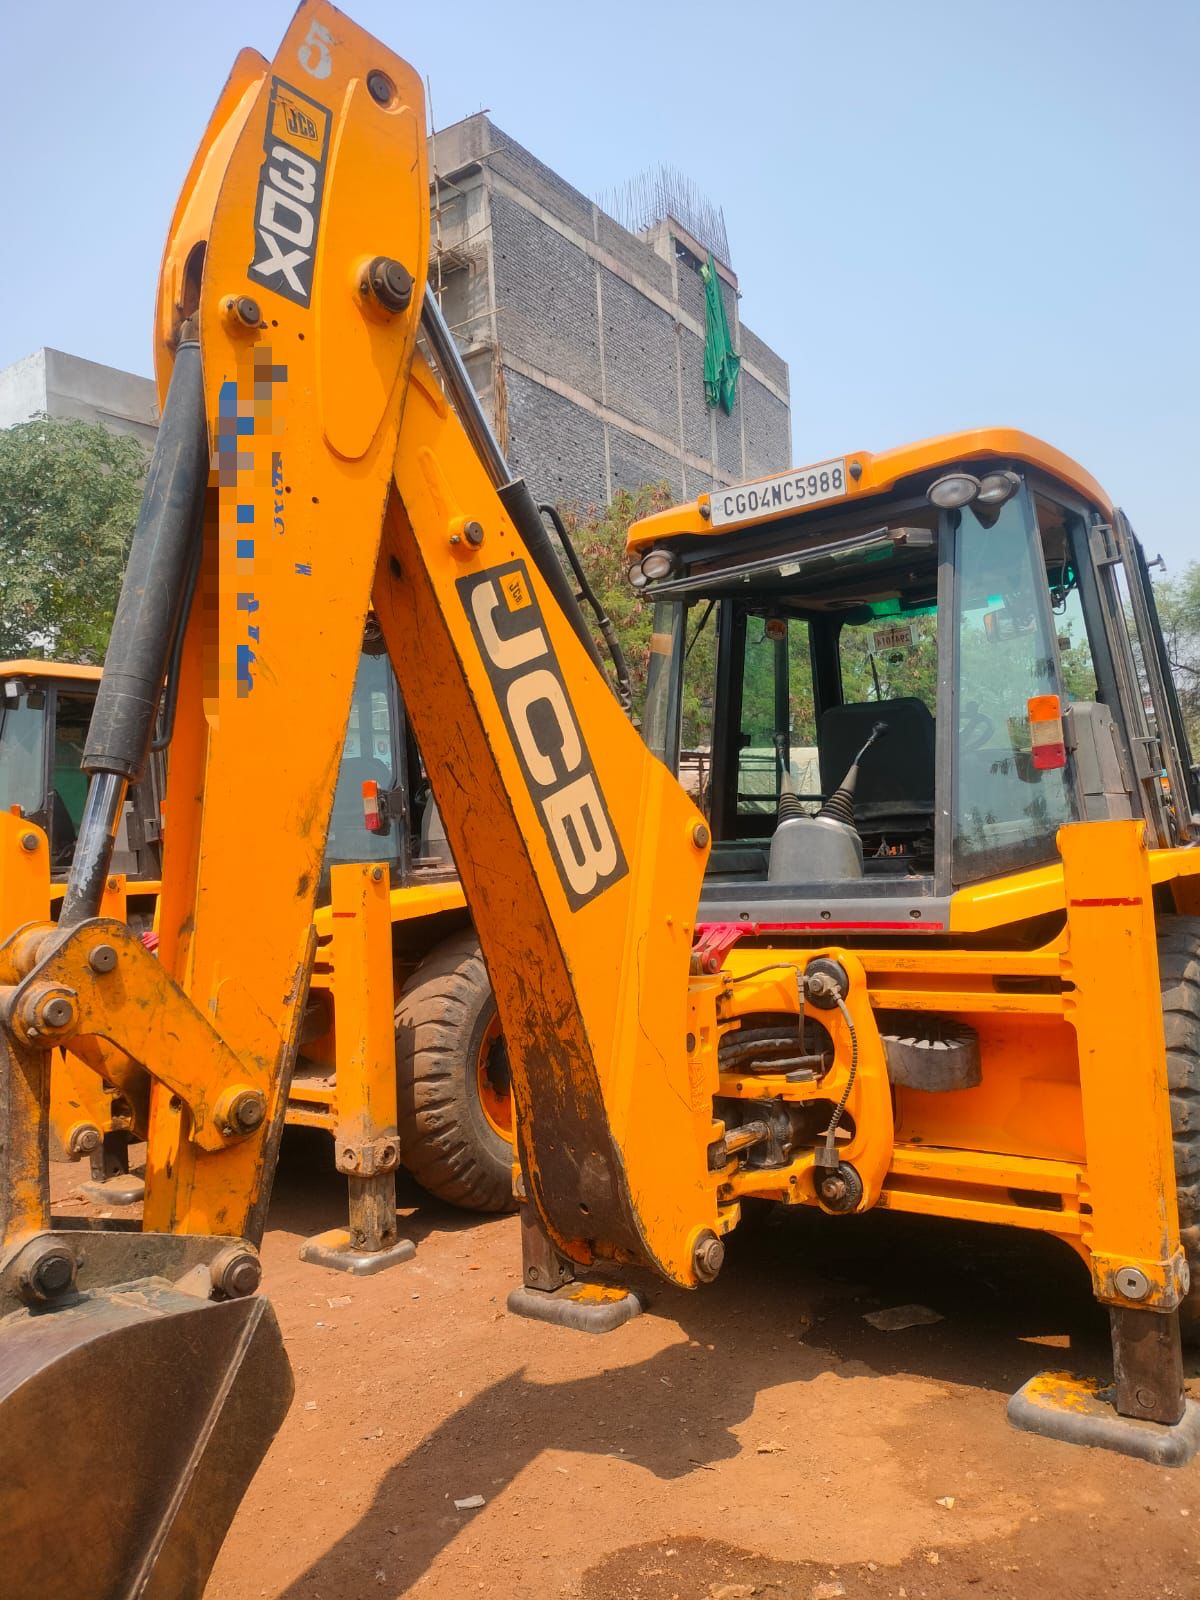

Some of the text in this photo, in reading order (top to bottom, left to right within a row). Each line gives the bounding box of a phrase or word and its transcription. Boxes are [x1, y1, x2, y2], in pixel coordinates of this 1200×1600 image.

[297, 18, 335, 80] 5
[288, 108, 316, 138] JCB
[251, 145, 317, 297] 3DX
[724, 468, 842, 516] CG04NC5988
[508, 581, 524, 603] JCB
[471, 580, 617, 895] JCB
